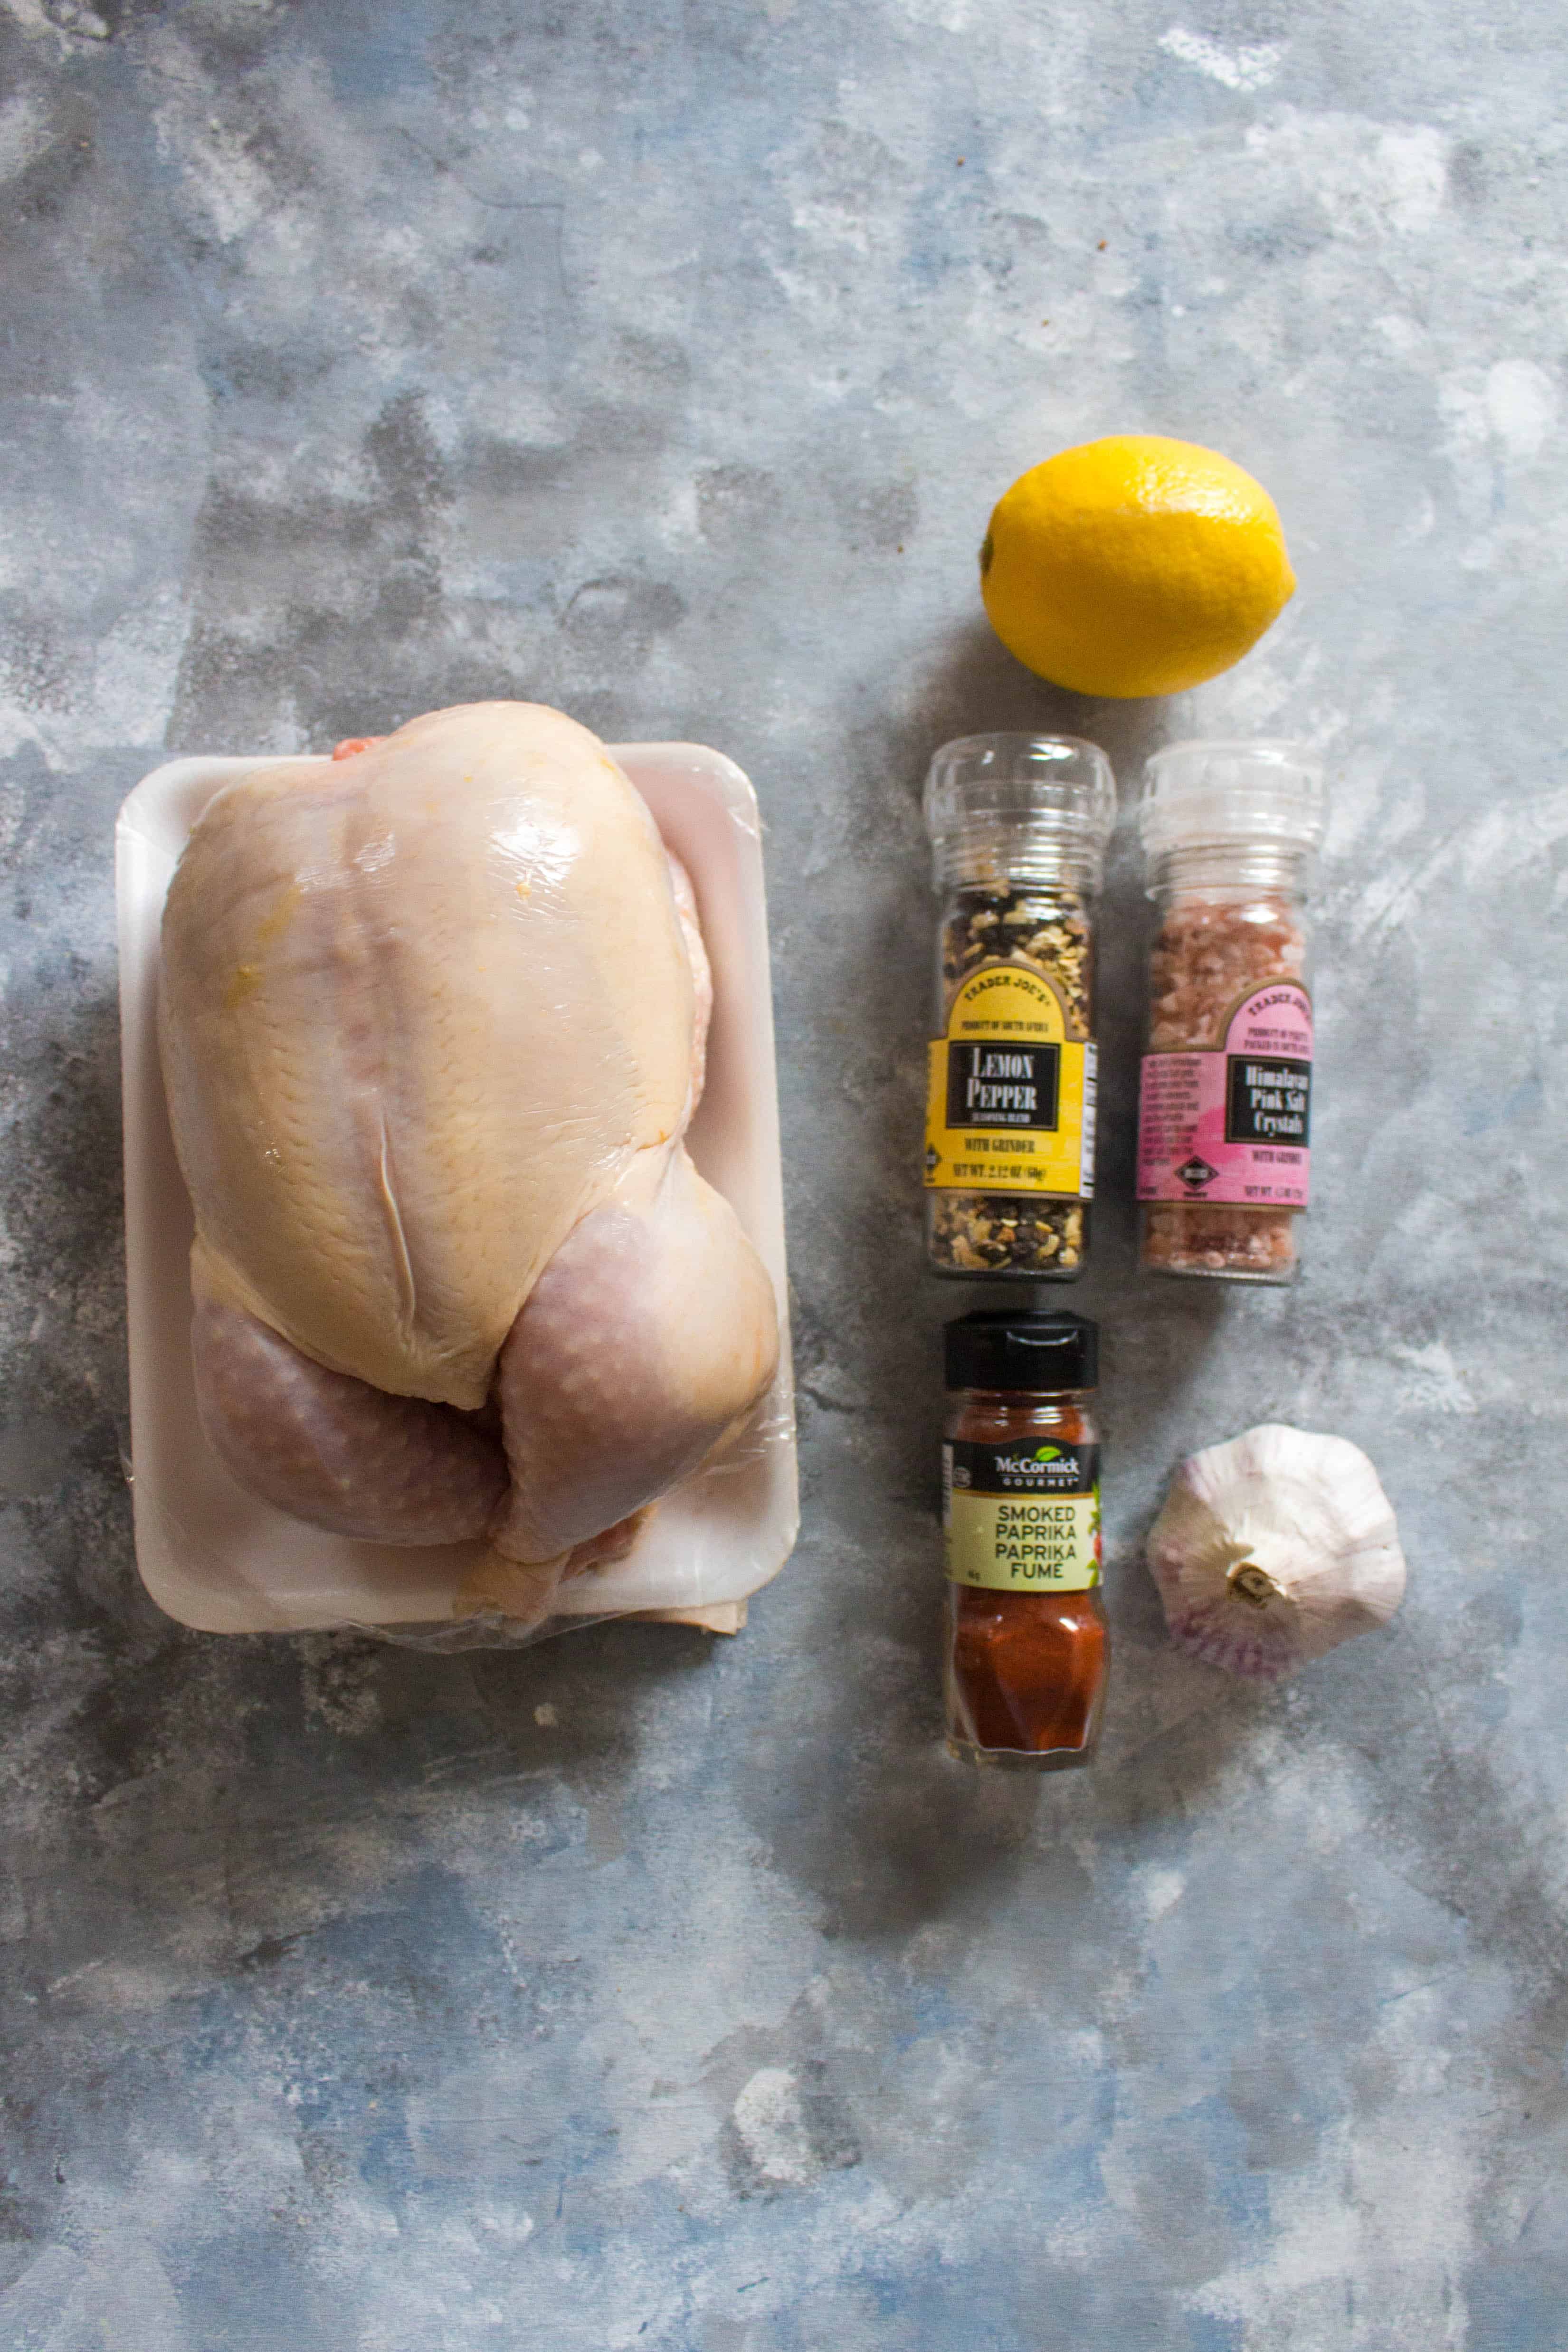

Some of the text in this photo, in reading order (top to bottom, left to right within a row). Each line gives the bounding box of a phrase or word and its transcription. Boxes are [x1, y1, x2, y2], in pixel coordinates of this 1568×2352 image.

[964, 975, 1010, 1001] TRADER
[971, 1047, 1035, 1079] LEMON
[966, 1076, 1037, 1111] PEPPER
[1250, 1088, 1306, 1113] Pink Salt
[965, 1138, 1035, 1153] WITH GRINDER
[995, 1456, 1080, 1475] McCormick
[998, 1505, 1076, 1522] SMOKED
[995, 1524, 1076, 1540] PAPRIKA
[995, 1543, 1076, 1560] PAPRIKA
